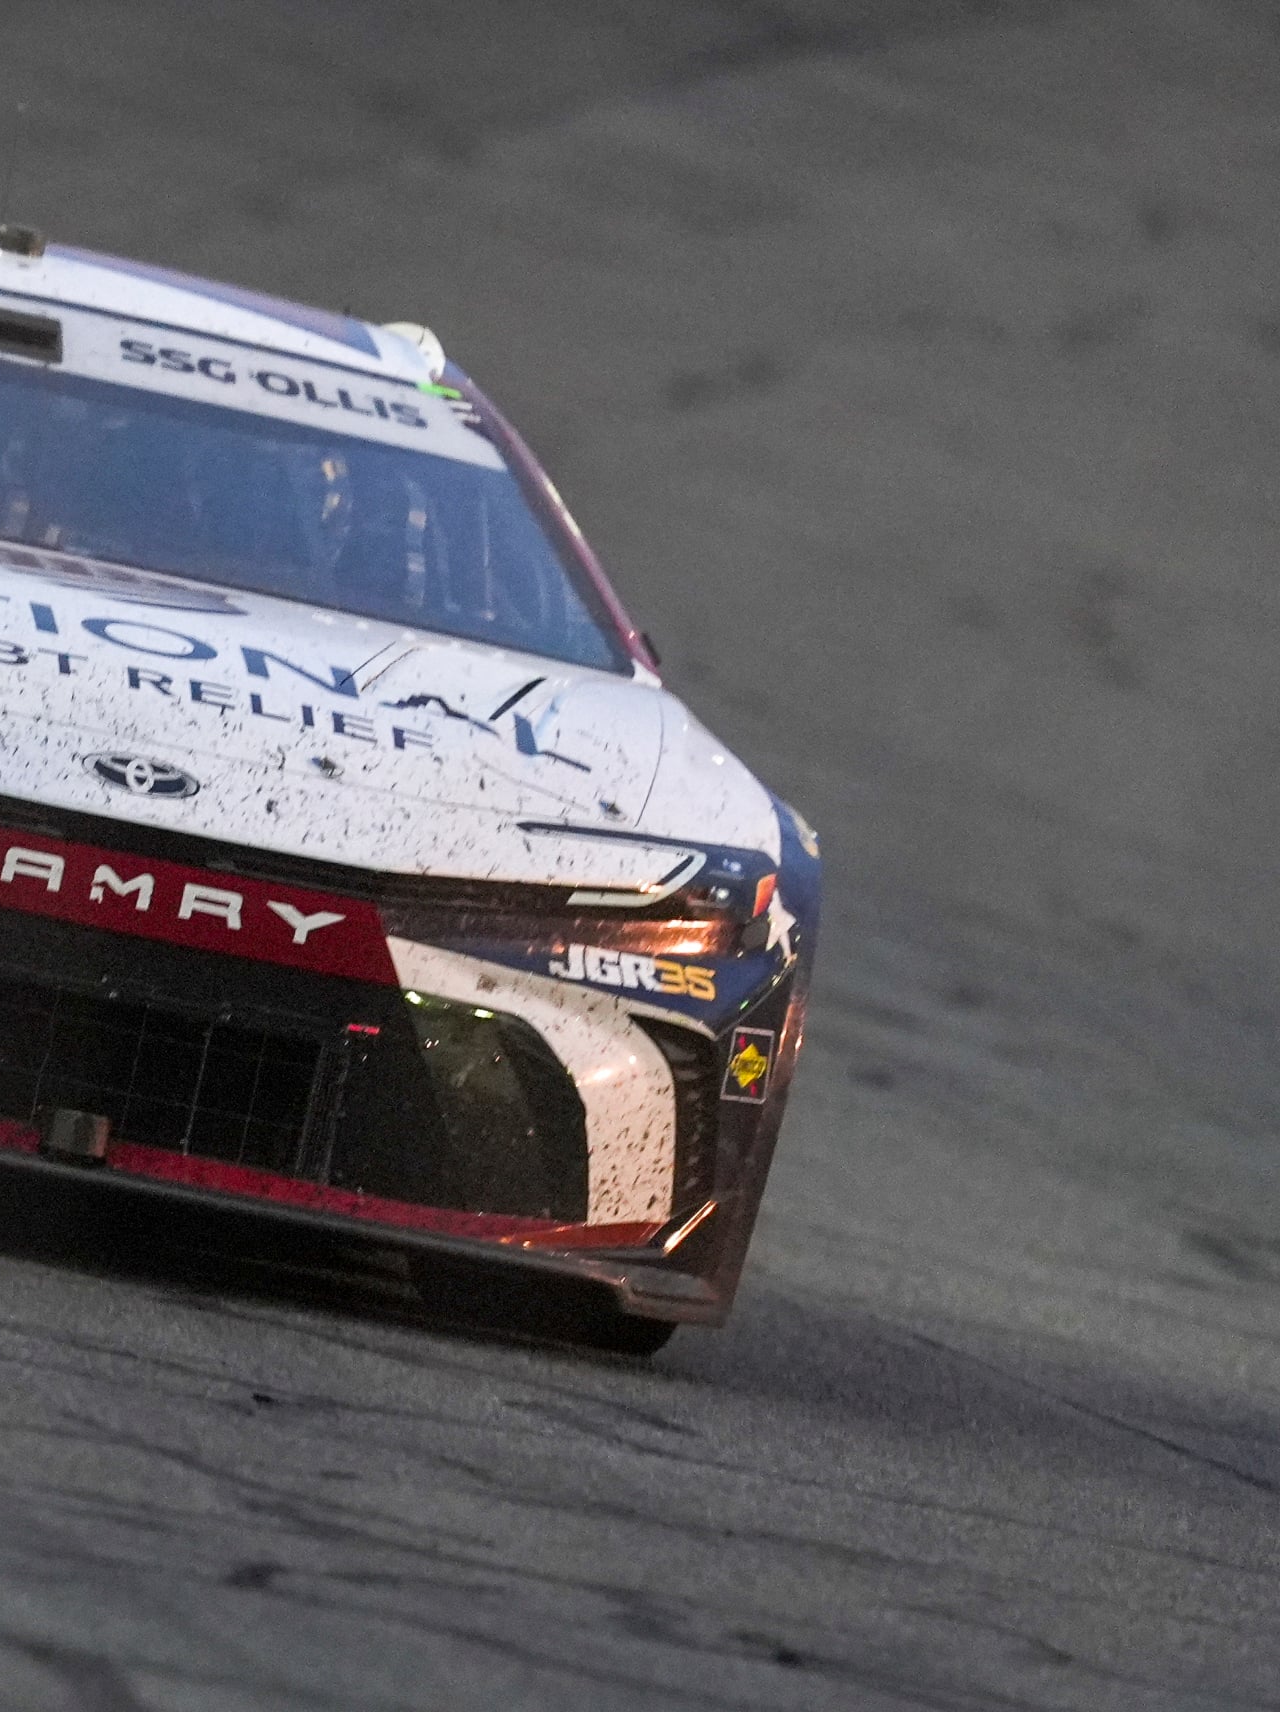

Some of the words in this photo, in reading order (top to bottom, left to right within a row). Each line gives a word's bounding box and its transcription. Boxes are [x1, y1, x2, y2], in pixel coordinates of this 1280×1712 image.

[119, 338, 237, 385] SSG
[254, 370, 428, 430] OLLIS
[126, 666, 434, 751] RELIEF
